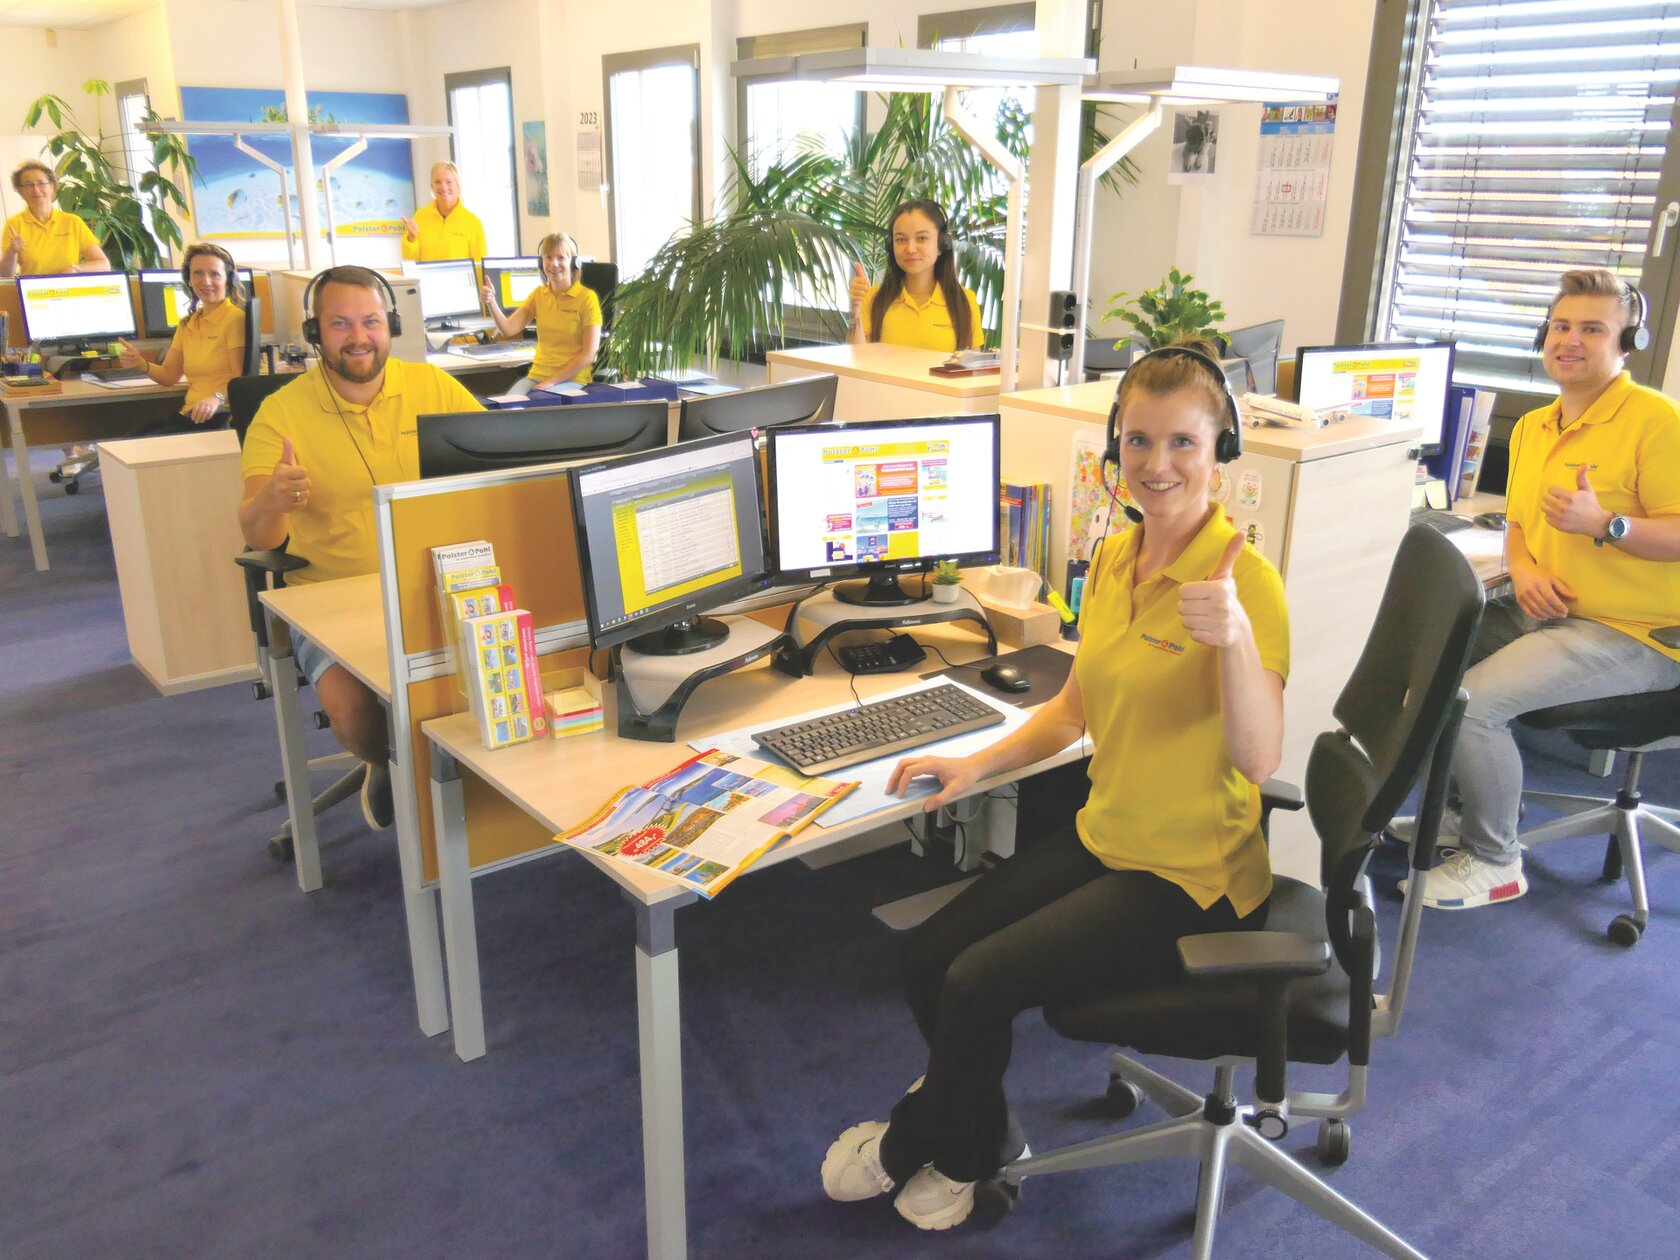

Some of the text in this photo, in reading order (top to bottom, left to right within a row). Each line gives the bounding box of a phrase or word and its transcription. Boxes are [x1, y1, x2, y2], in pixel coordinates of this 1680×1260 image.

[580, 112, 597, 125] 2023
[352, 224, 406, 233] Polster Pohl
[823, 448, 851, 456] Polster
[442, 550, 468, 560] Polster
[475, 546, 491, 554] Pohl
[451, 568, 496, 580] Polster Pohl
